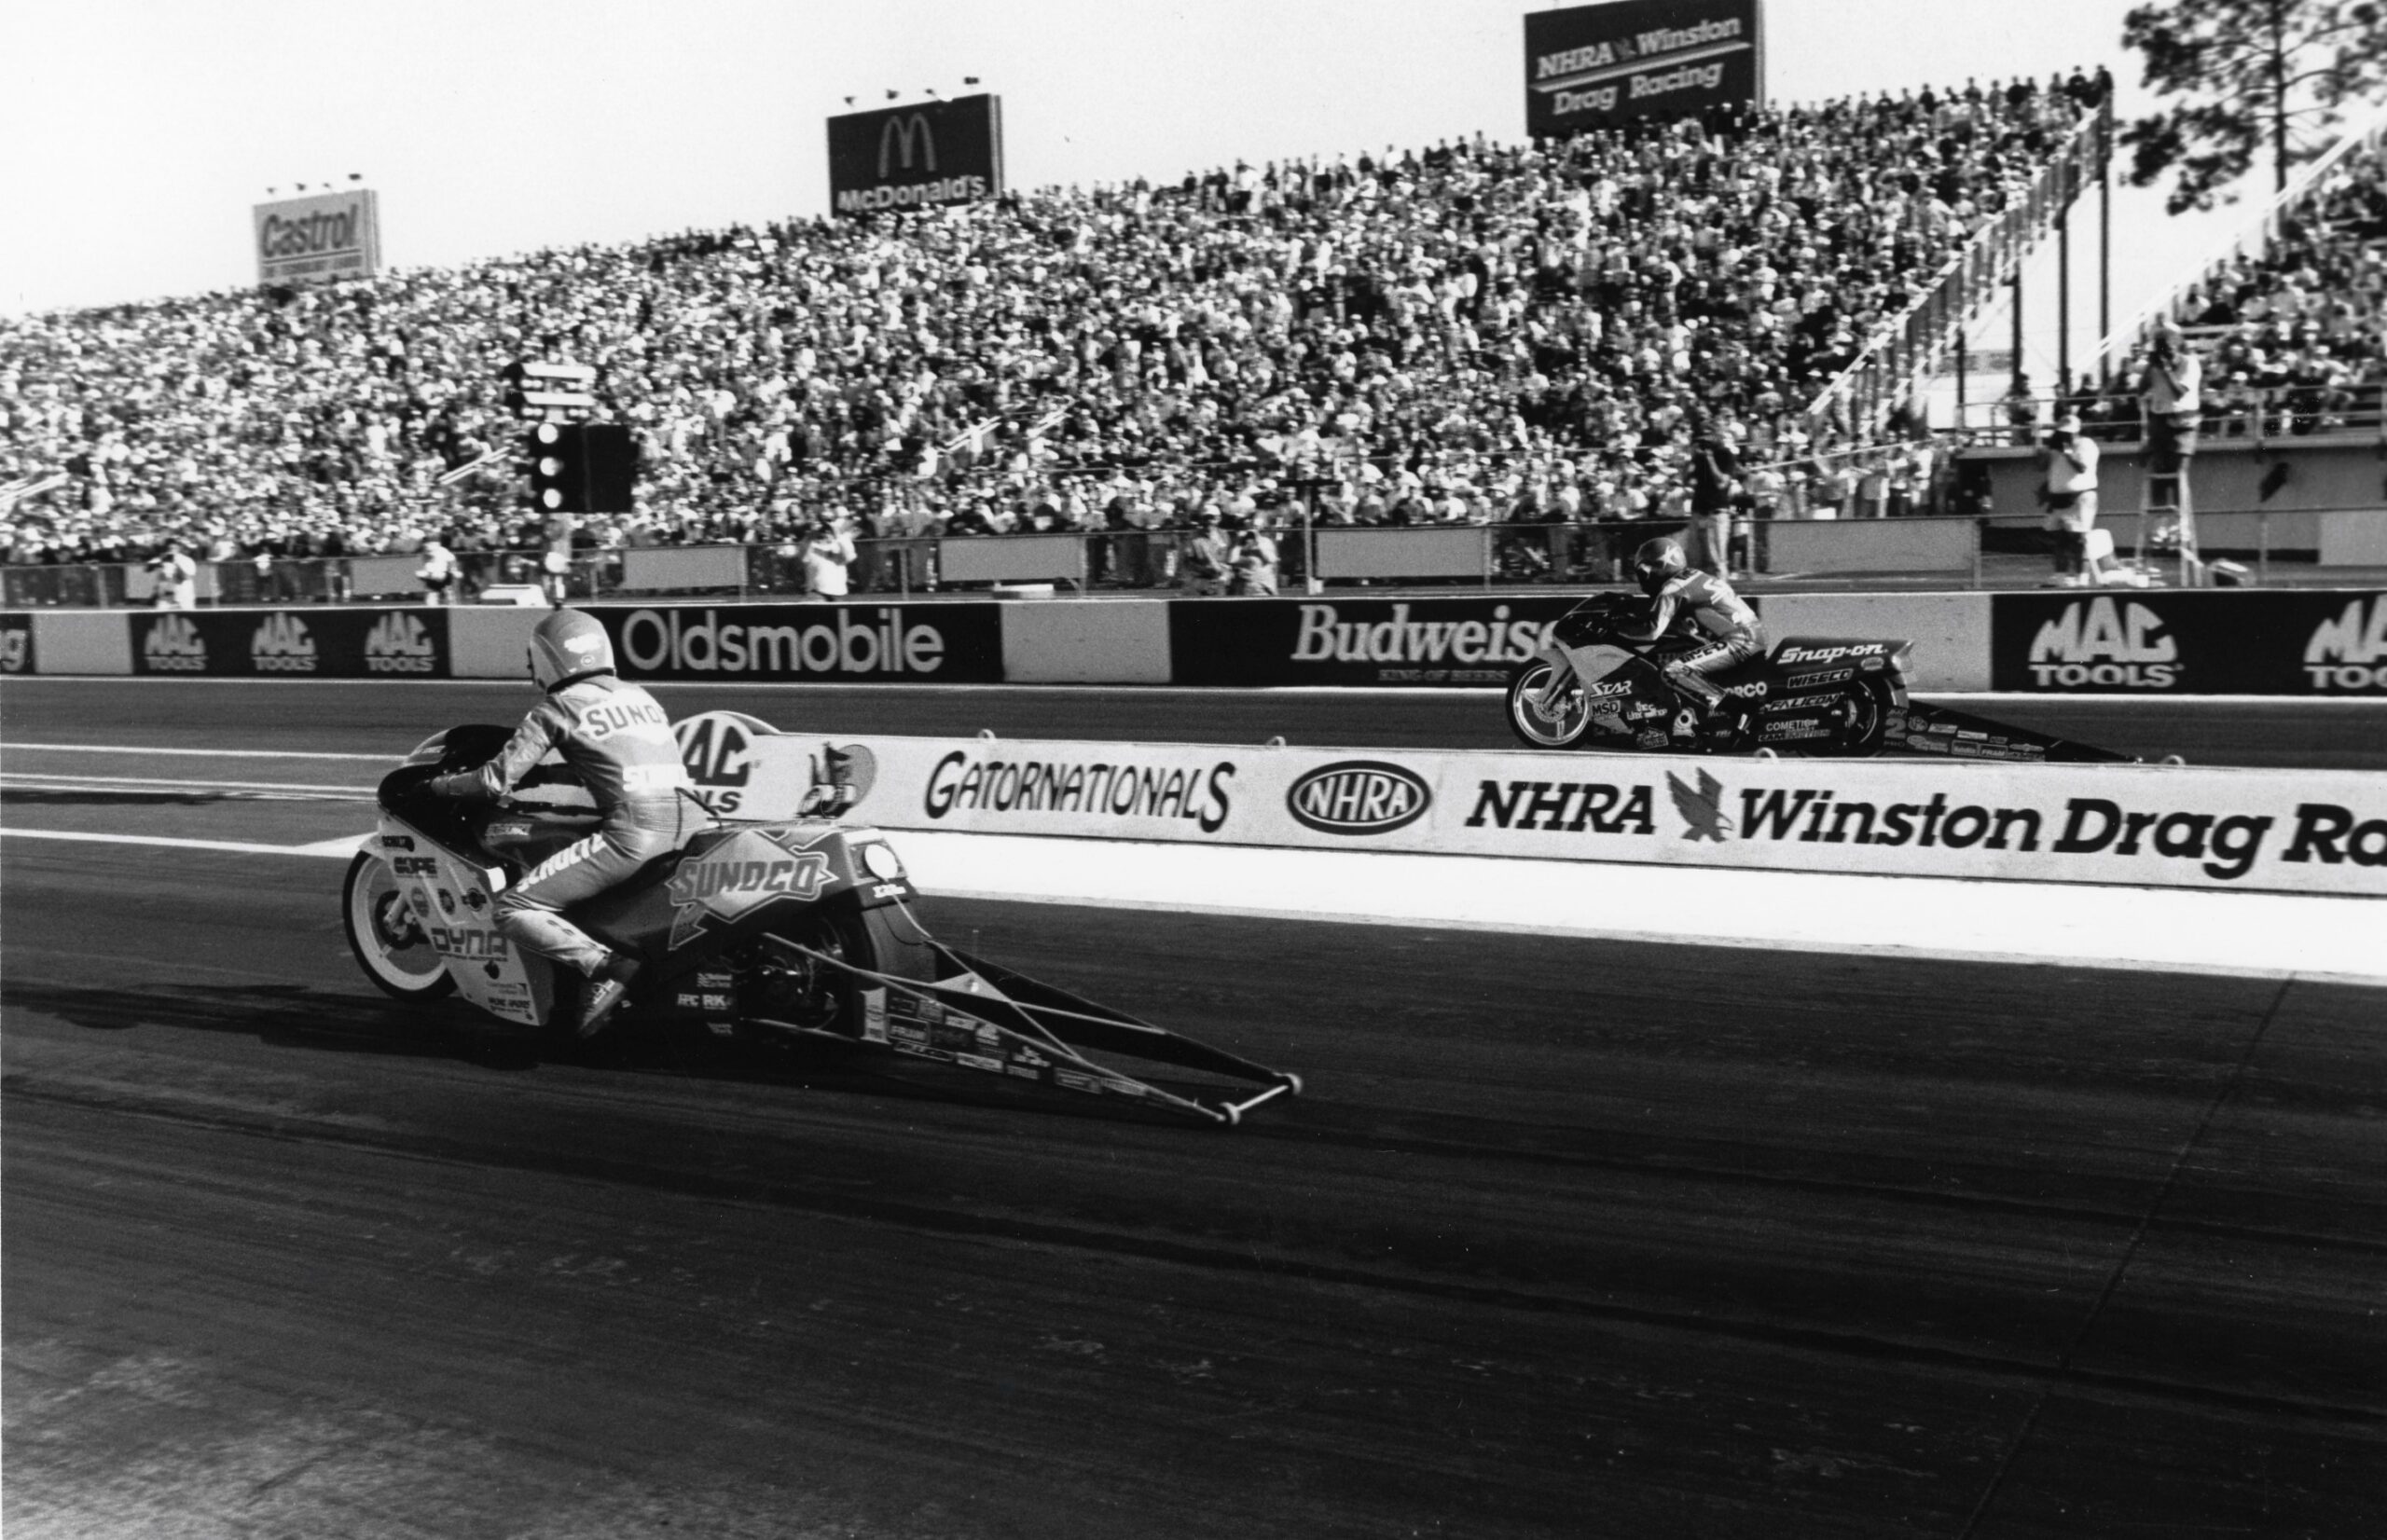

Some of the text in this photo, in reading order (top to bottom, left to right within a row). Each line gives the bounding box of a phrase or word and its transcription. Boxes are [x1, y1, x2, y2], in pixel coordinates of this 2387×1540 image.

[1536, 18, 1742, 78] NHRA Winston
[1552, 62, 1724, 115] Drag Racing
[837, 174, 987, 212] McDonald's
[262, 204, 358, 258] Castrol
[622, 608, 945, 673] Oldsmobile
[1290, 604, 1558, 664] Budweis
[2028, 597, 2177, 663] MAC
[2303, 595, 2387, 663] MA
[145, 654, 209, 670] TOOLS
[252, 655, 319, 671] TOOLS
[365, 655, 437, 672] TOOLS
[1777, 644, 1883, 664] Snap-on
[1591, 681, 1632, 698] STAR
[1789, 669, 1853, 687] WISECO
[2028, 665, 2176, 688] TOOLS
[2303, 666, 2387, 689] TOO
[1592, 701, 1621, 716] MSD
[1883, 717, 1907, 738] 2
[675, 718, 750, 787] AC
[925, 751, 1235, 832] GATORNATIONALS
[1304, 773, 1410, 821] NHRA
[1465, 780, 1656, 835] NHRA
[1739, 789, 2042, 852] Winston
[2051, 798, 2275, 880] Drag
[676, 860, 819, 899] SUNOCO
